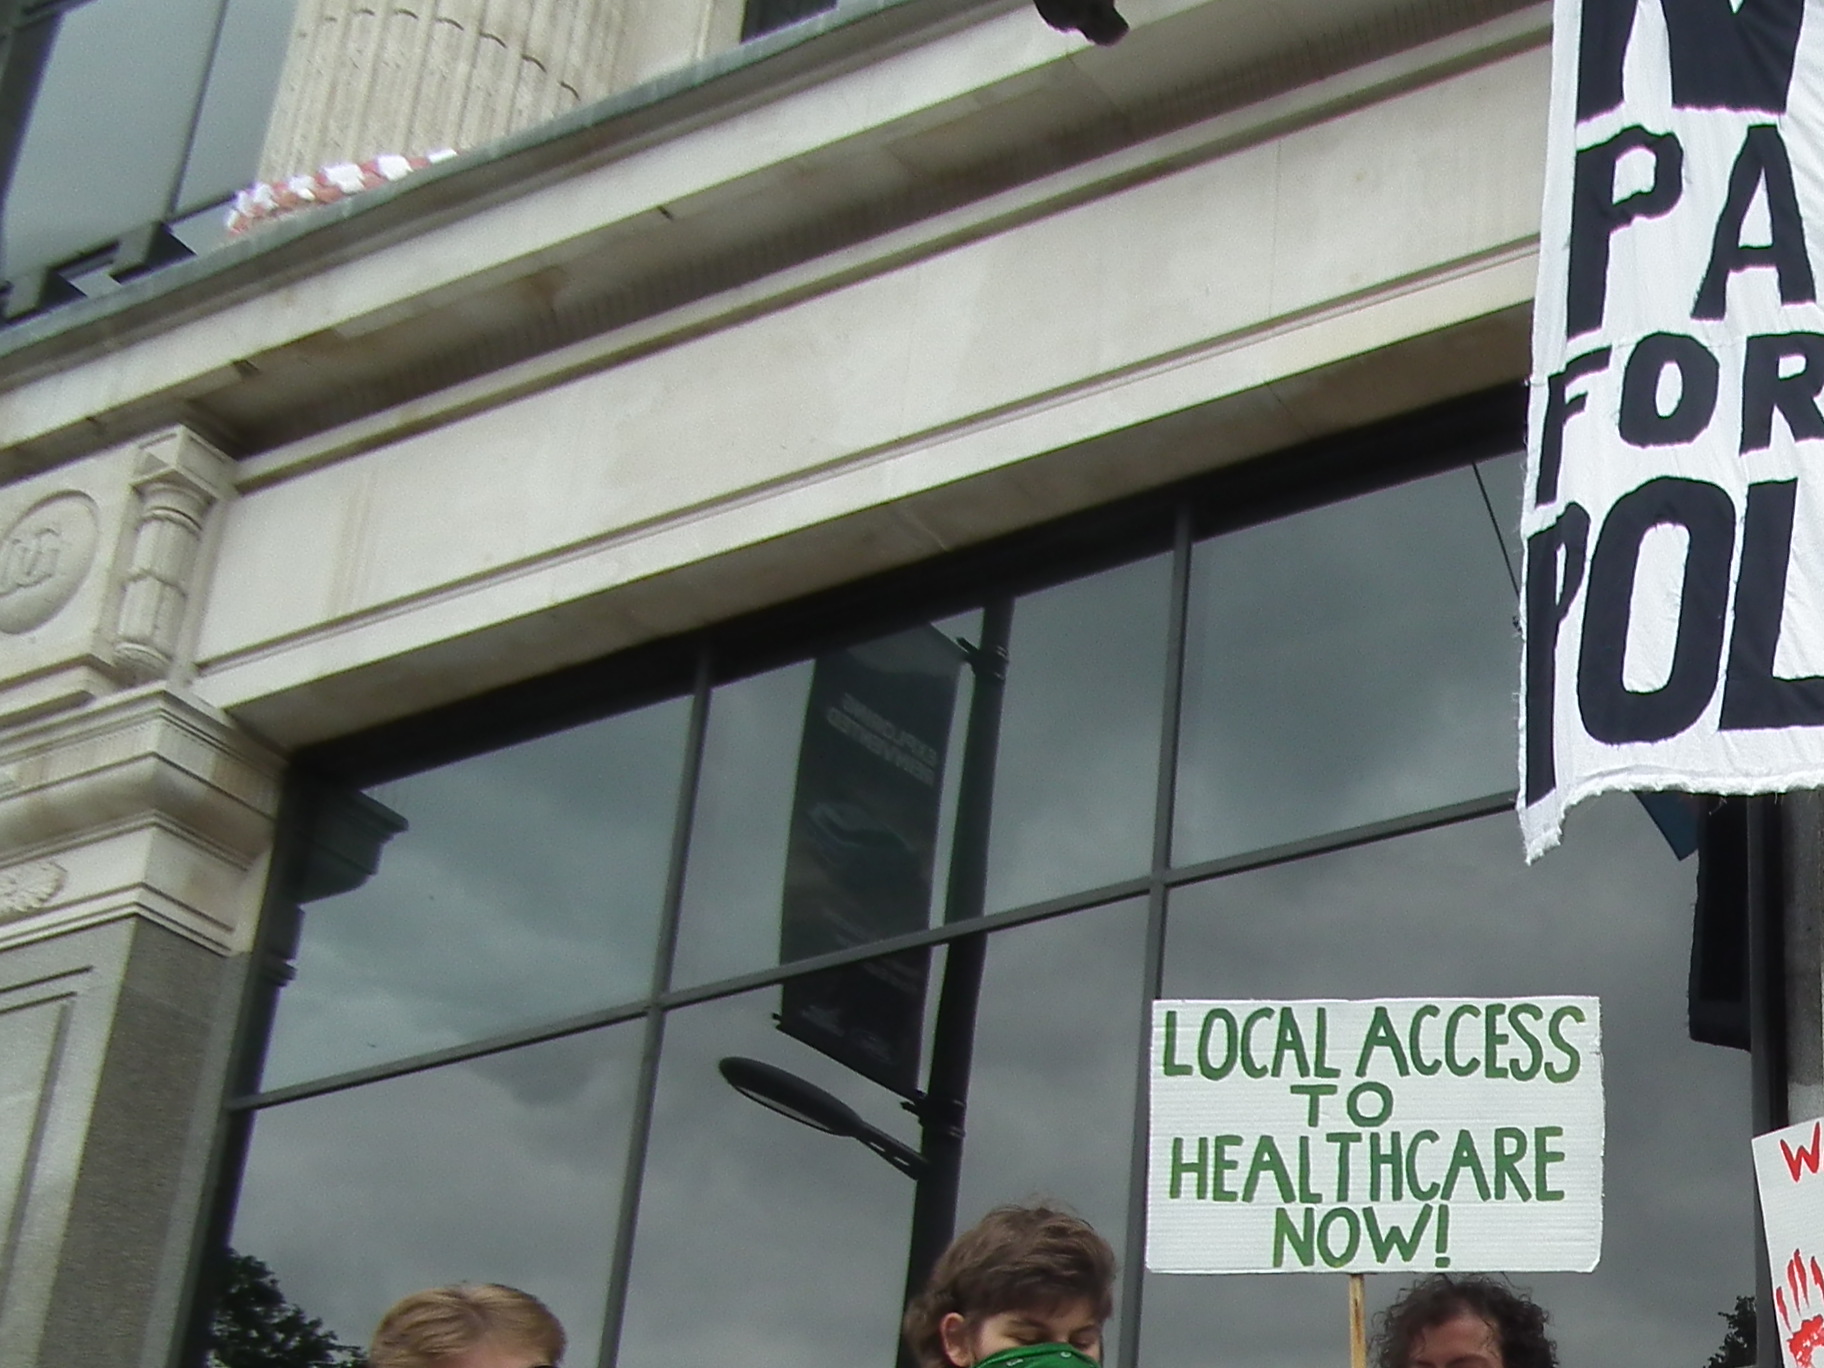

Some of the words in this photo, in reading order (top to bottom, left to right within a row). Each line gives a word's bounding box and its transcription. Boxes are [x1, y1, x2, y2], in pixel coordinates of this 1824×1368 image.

[1162, 1006, 1341, 1080] LOCAL
[1356, 1003, 1586, 1083] ACCESS
[1290, 1081, 1394, 1128] TO
[1169, 1126, 1566, 1203] HEALTHCARE
[1272, 1204, 1451, 1269] NOW!
